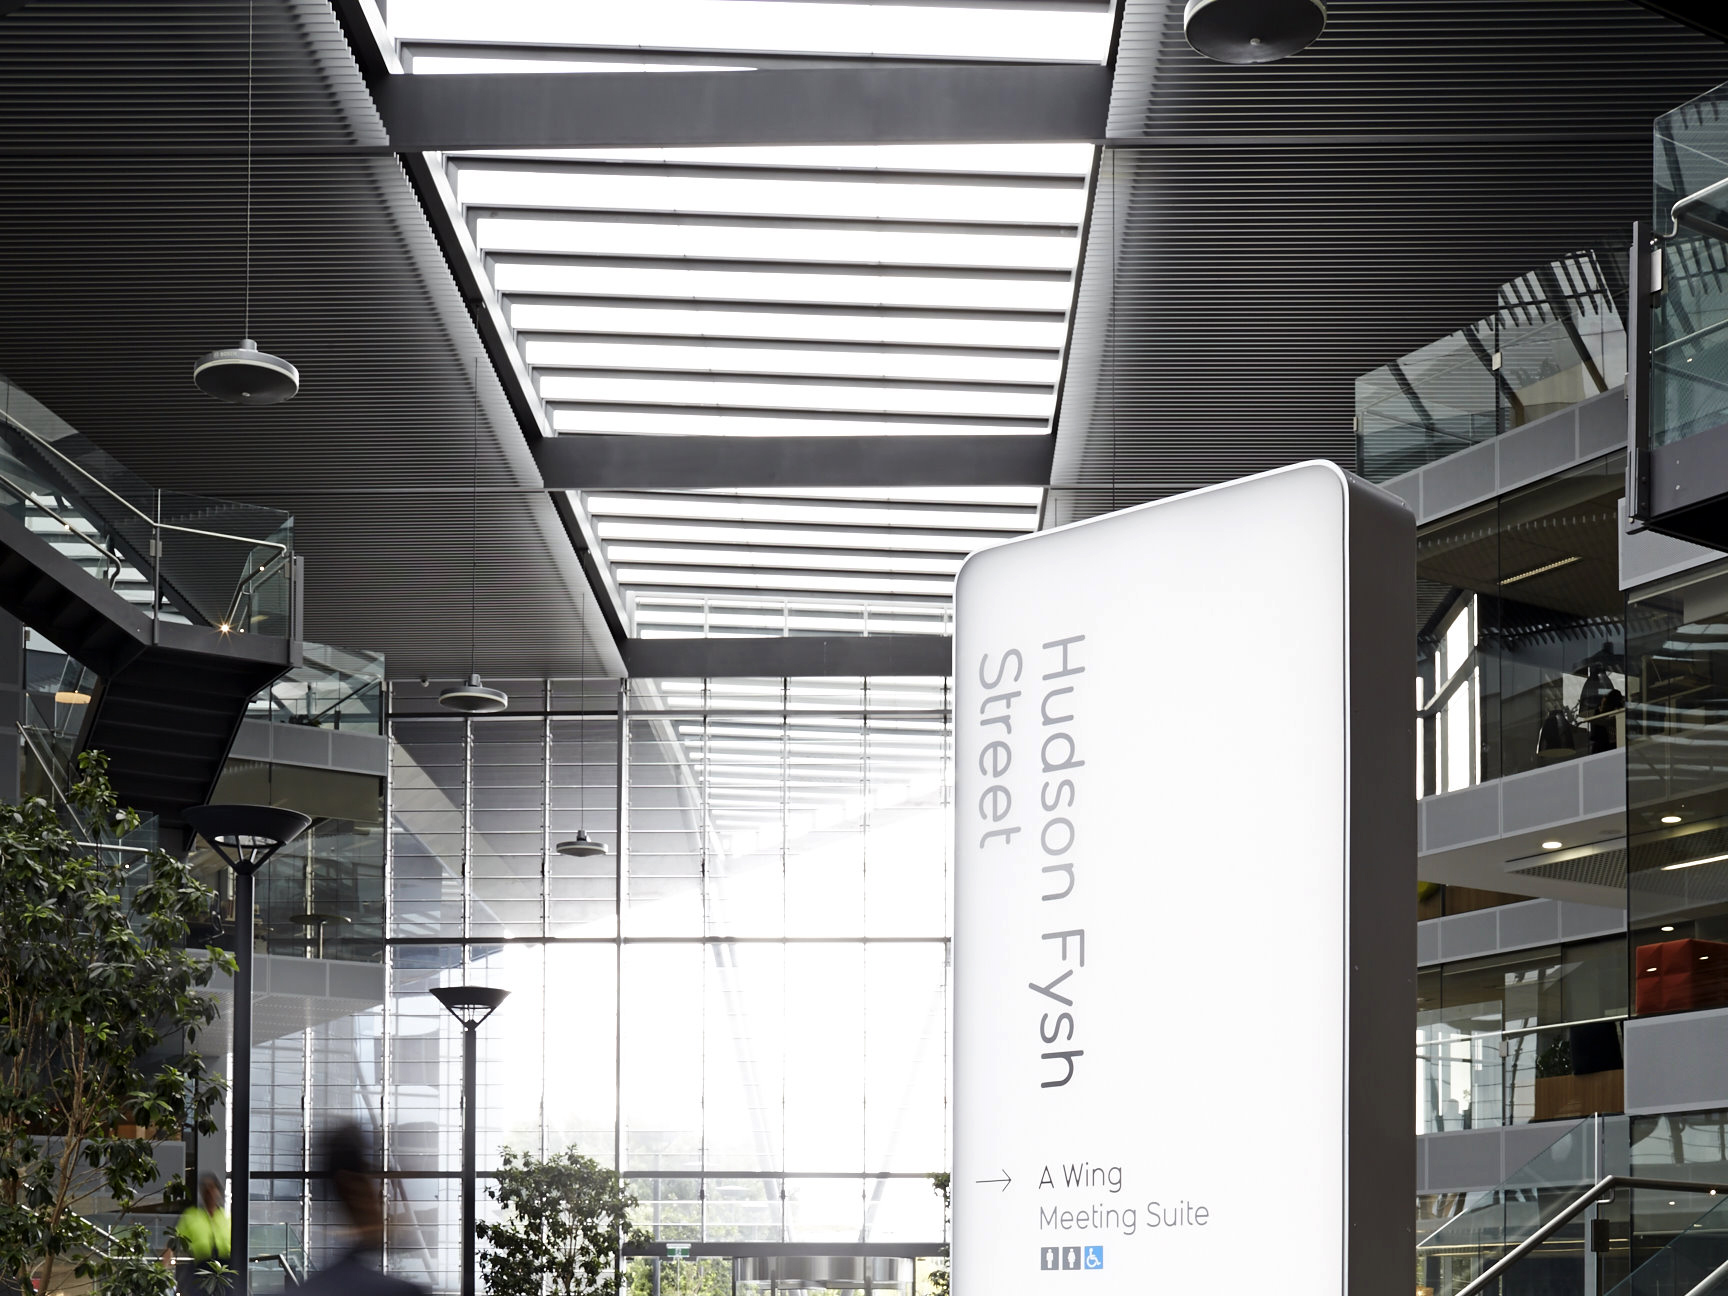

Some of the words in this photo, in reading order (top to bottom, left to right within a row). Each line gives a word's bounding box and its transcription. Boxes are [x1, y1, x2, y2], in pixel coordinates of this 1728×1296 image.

[979, 649, 1023, 849] Street
[1041, 635, 1085, 901] Hudson
[1029, 929, 1085, 1088] Fysh
[1039, 1165, 1054, 1189] A
[1063, 1162, 1121, 1193] Wing
[1040, 1203, 1136, 1235] Meeting
[1147, 1200, 1209, 1227] Suite
